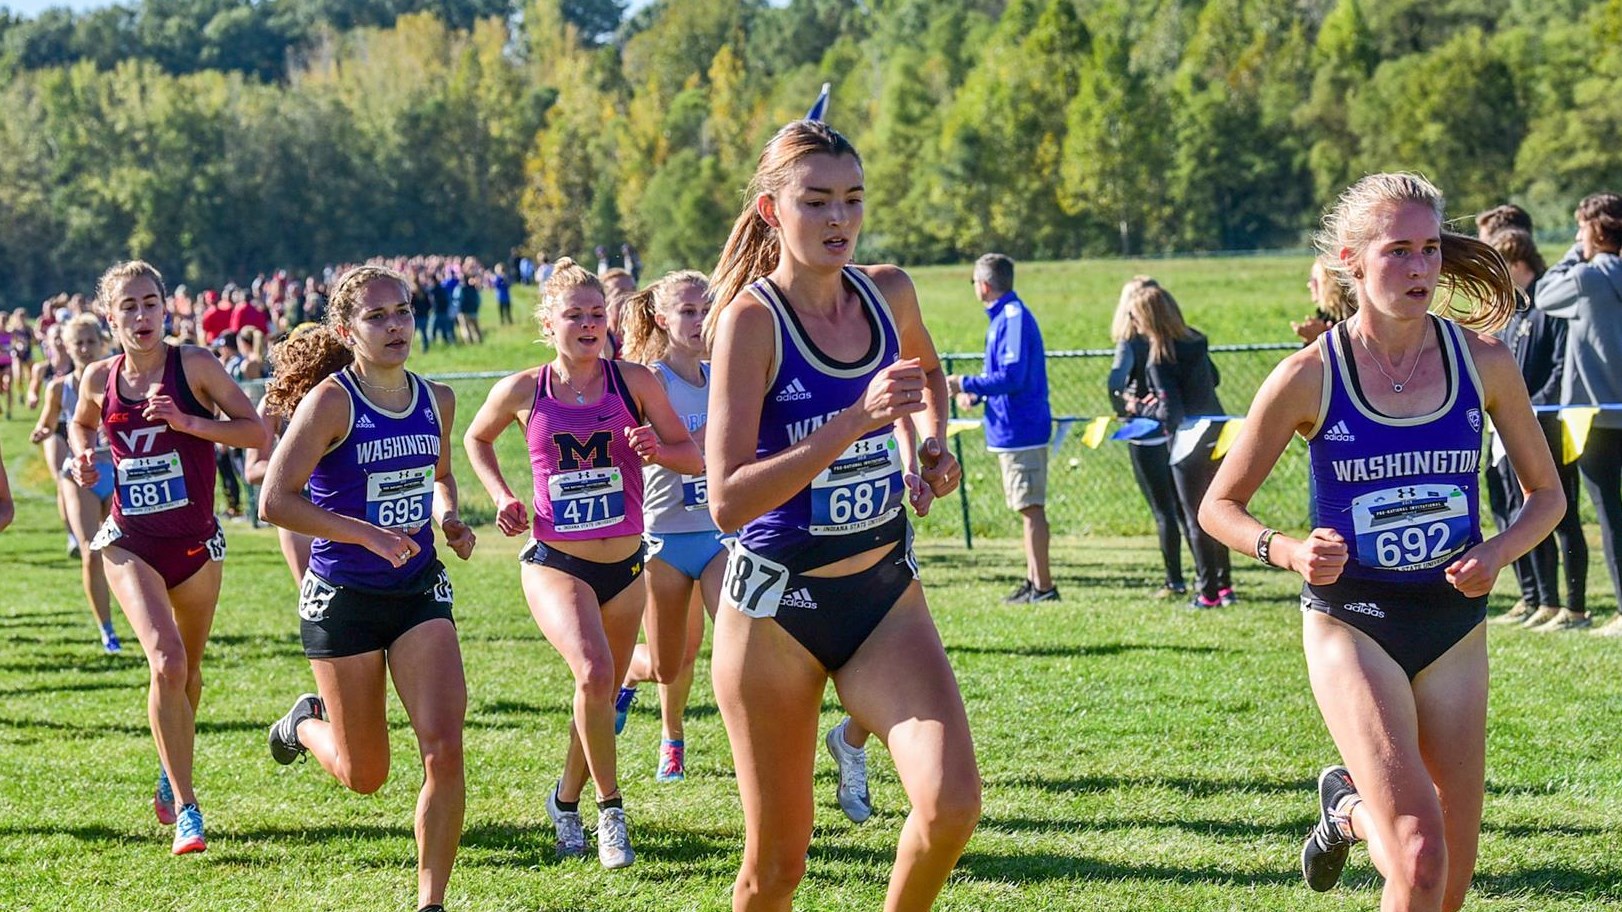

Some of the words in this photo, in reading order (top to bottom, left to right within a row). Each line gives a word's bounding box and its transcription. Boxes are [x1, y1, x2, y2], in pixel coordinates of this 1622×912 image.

[776, 390, 812, 402] adidas
[108, 412, 129, 423] ACC
[117, 424, 168, 453] VT
[553, 430, 613, 471] M
[1324, 432, 1355, 442] adidas
[1332, 449, 1480, 483] WASHINGTON
[129, 480, 171, 508] 681
[830, 477, 891, 524] 687
[378, 495, 424, 527] 695
[563, 494, 610, 524] 471
[1376, 522, 1452, 567] 692
[779, 598, 818, 610] adidas
[1343, 603, 1386, 618] adidas
